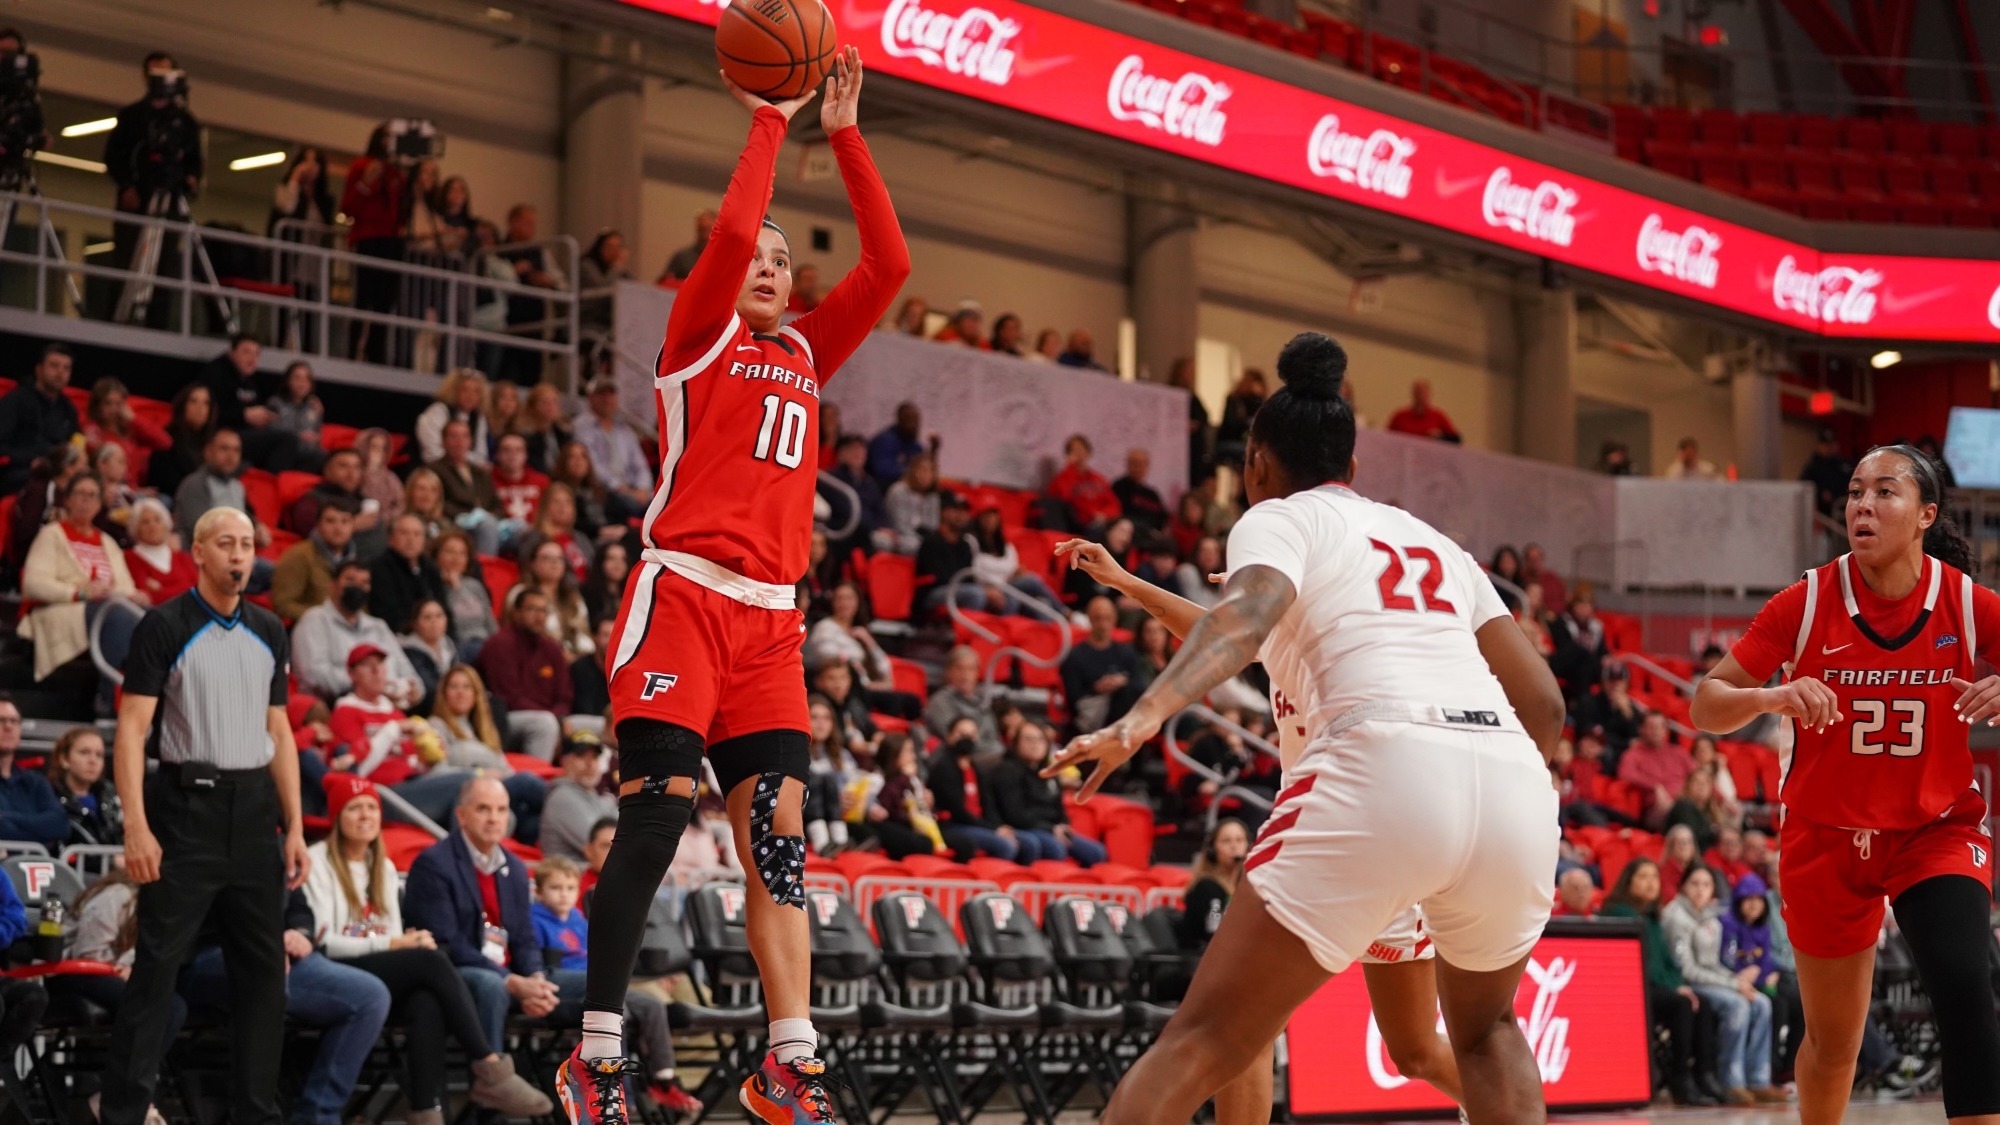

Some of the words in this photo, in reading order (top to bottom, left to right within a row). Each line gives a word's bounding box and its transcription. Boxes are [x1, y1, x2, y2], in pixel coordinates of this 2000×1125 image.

[728, 360, 820, 401] FAIRFIEL
[752, 393, 808, 470] 10
[1366, 536, 1458, 617] 22
[640, 671, 678, 701] F
[1823, 667, 1954, 686] FAIRFIELD
[1851, 698, 1926, 757] 23
[1367, 940, 1404, 962] SHU
[771, 1083, 787, 1100] 13
